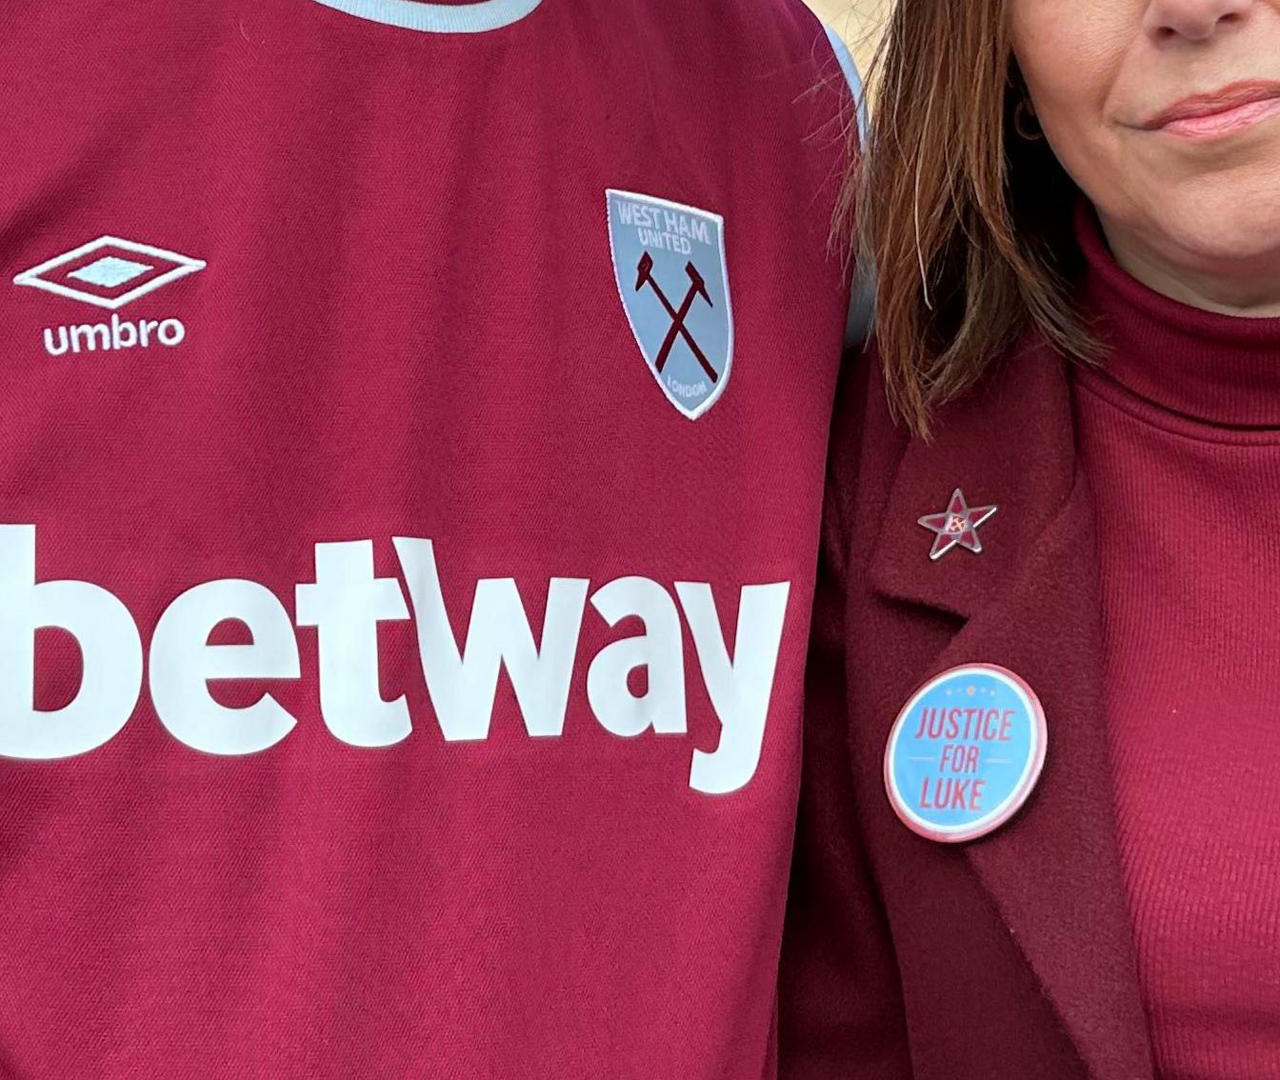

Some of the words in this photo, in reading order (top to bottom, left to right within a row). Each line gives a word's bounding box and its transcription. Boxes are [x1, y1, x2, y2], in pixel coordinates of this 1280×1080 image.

[618, 201, 662, 229] WEST
[664, 210, 711, 245] HAM
[638, 228, 691, 255] UNITED
[44, 313, 185, 356] umbro
[667, 375, 707, 398] LONDON
[915, 707, 1016, 742] JUSTICE
[939, 744, 980, 774] FOR
[920, 777, 986, 811] LUKE
